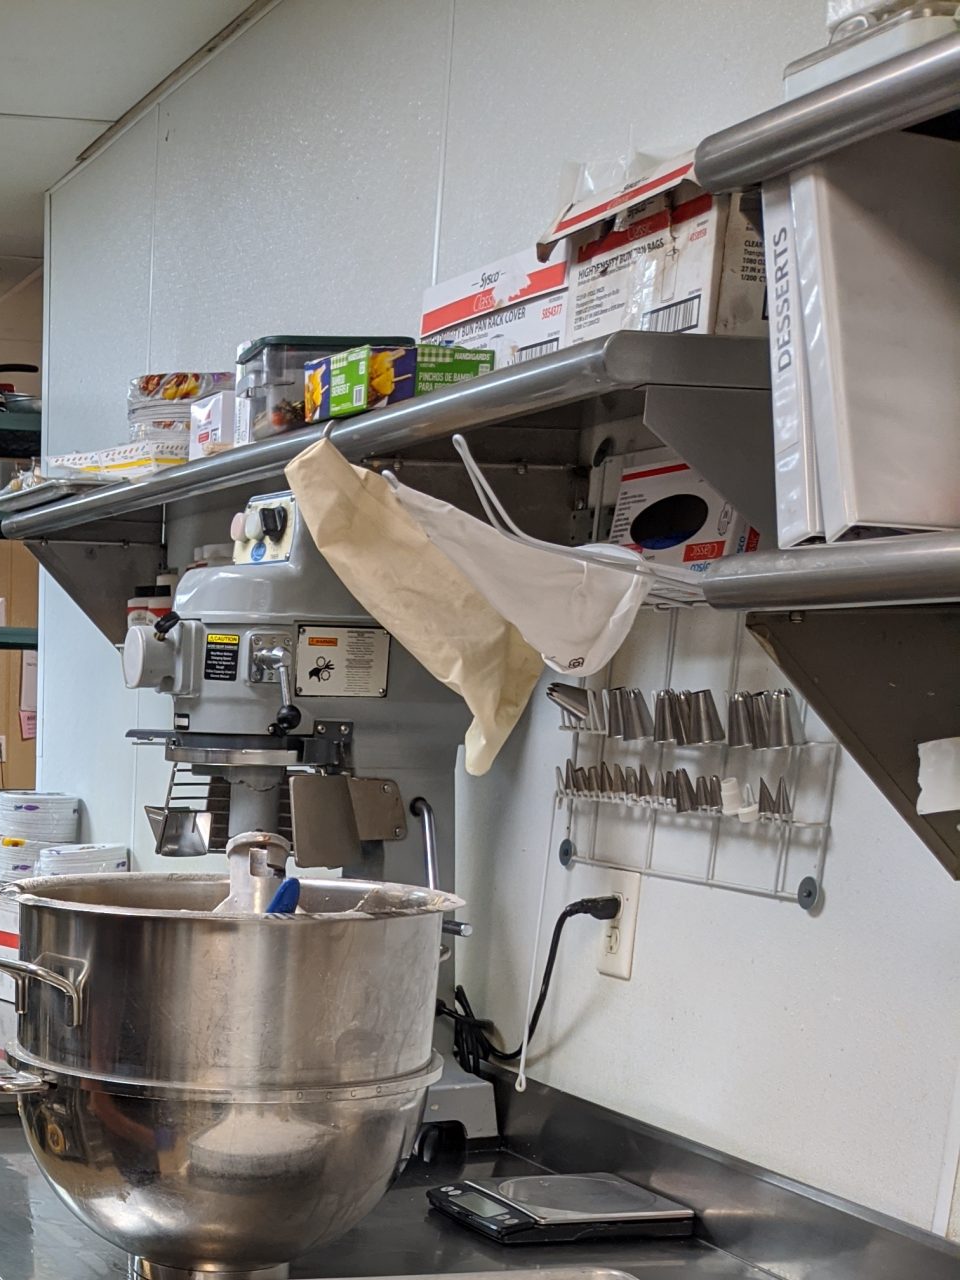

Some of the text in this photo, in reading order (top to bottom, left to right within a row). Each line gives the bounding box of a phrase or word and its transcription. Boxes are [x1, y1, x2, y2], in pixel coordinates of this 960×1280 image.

[647, 238, 665, 252] BAGS
[773, 226, 792, 373] DESSERTS
[488, 313, 503, 330] RACK
[504, 306, 526, 324] COVER
[419, 372, 444, 382] PINCHOS
[445, 372, 453, 382] DE
[418, 382, 433, 392] PARA
